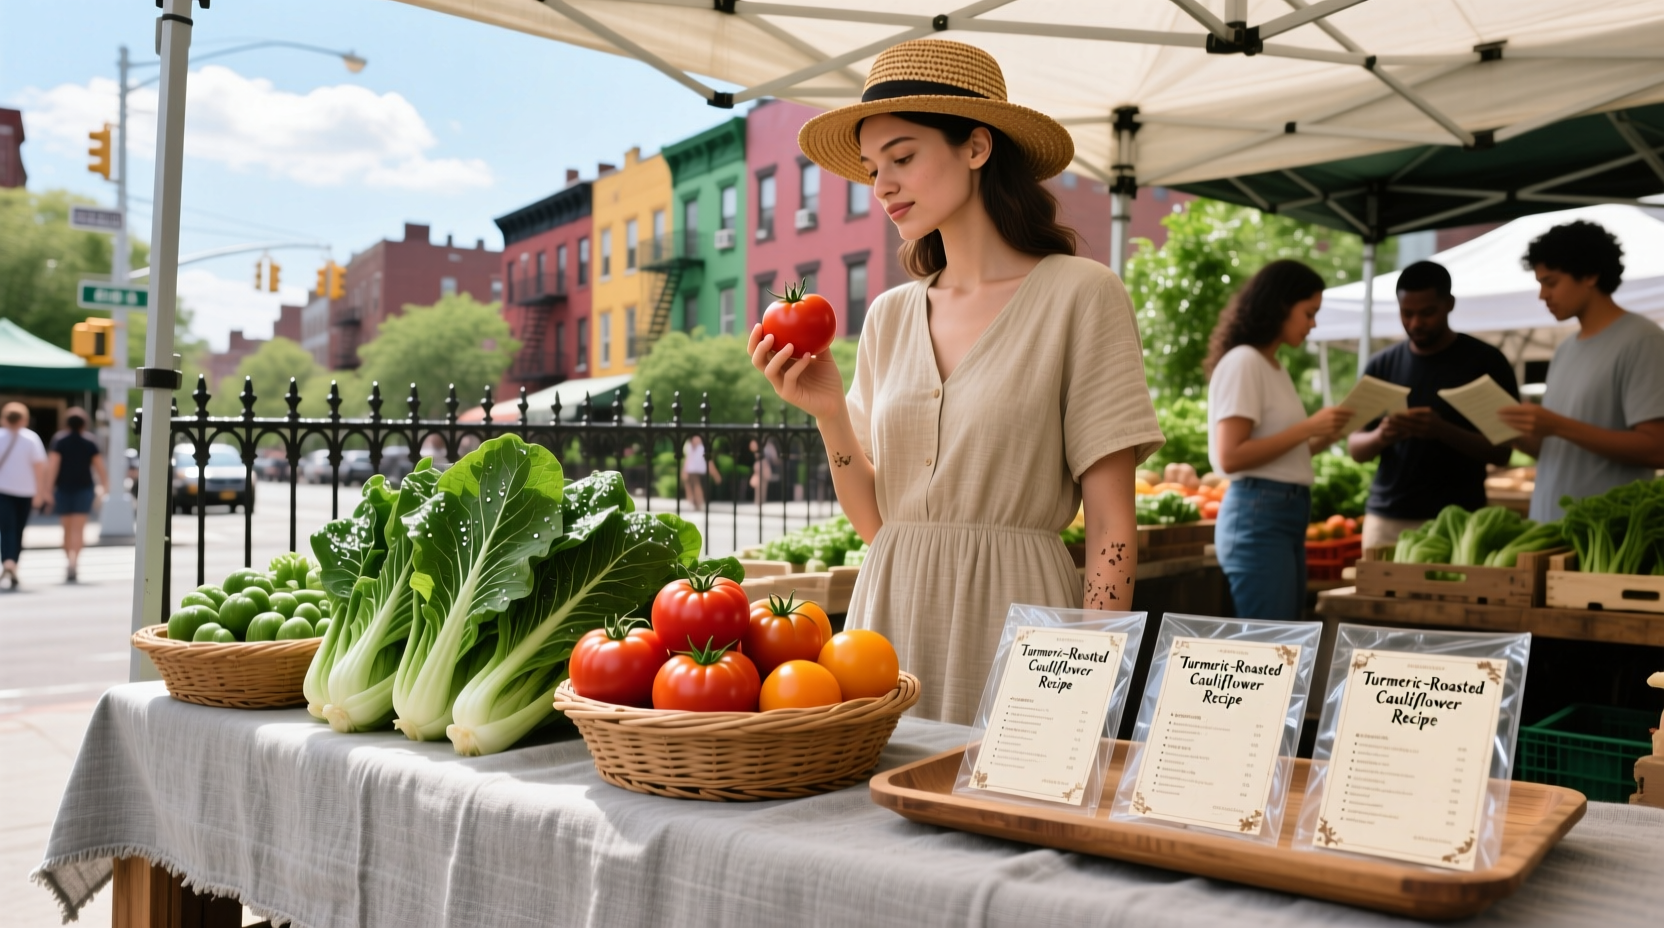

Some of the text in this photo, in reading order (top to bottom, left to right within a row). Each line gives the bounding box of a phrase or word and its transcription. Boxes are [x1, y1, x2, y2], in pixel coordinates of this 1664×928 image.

[1363, 671, 1485, 695] Turmeric-Roasted
[1376, 690, 1462, 710] Cauliflower
[1391, 708, 1438, 731] Recipe
